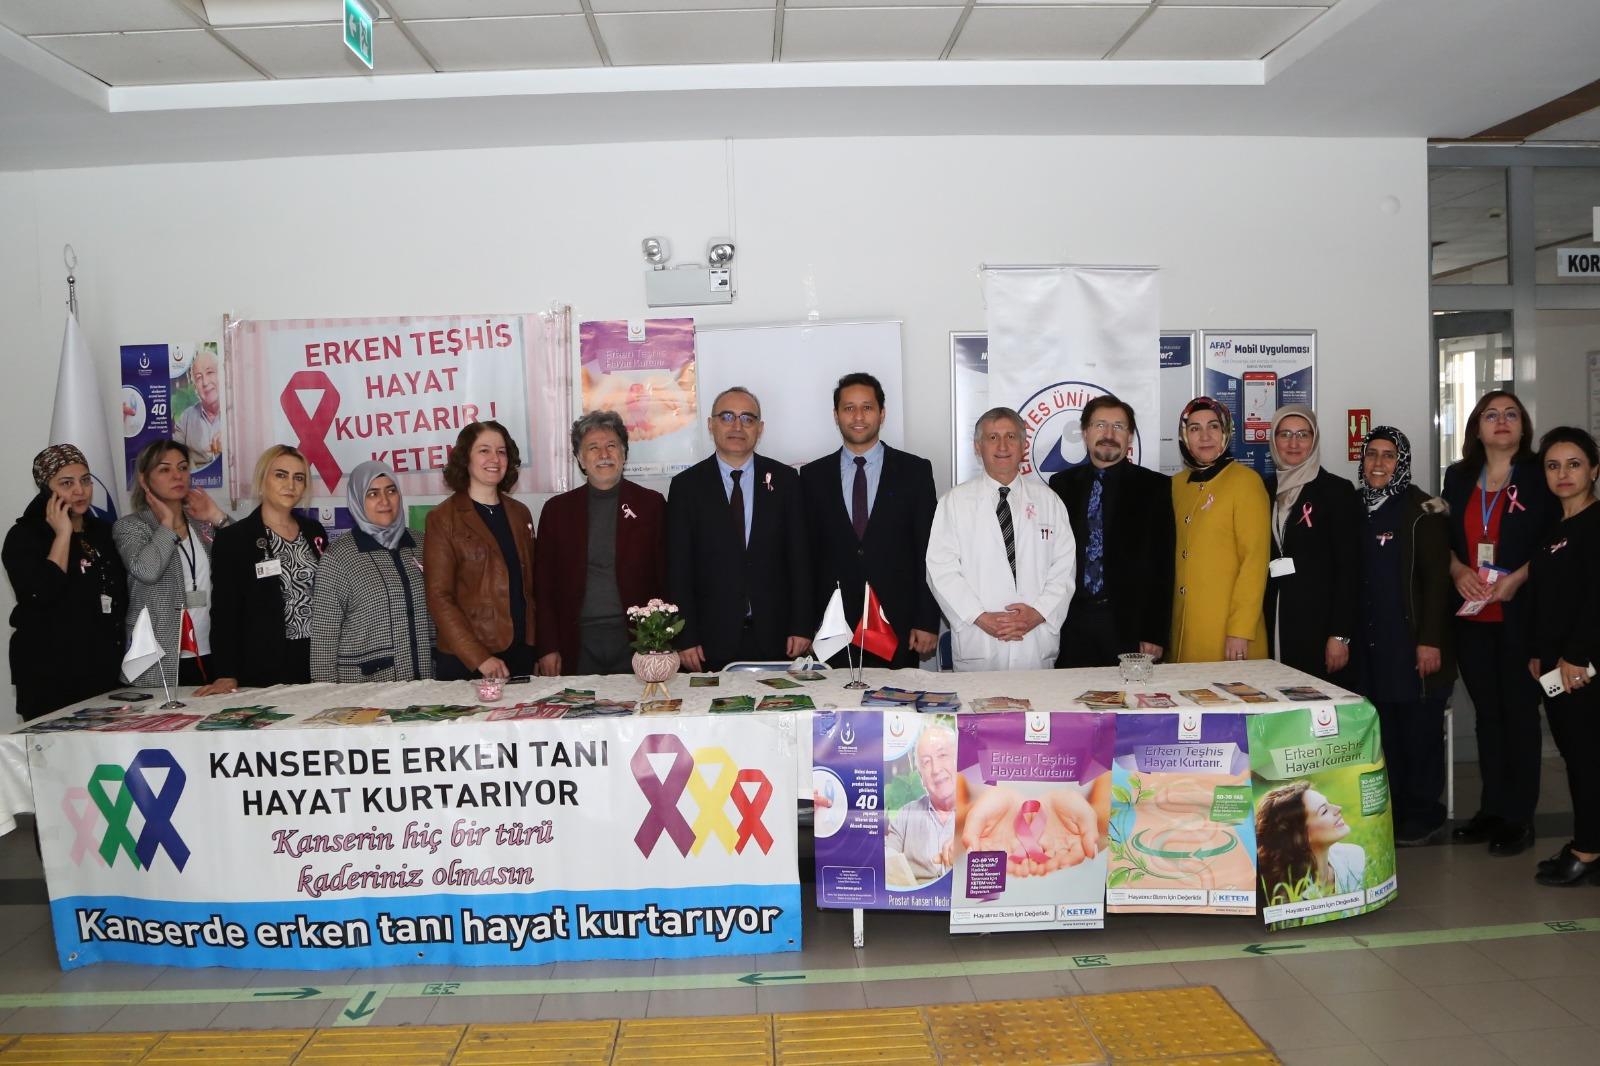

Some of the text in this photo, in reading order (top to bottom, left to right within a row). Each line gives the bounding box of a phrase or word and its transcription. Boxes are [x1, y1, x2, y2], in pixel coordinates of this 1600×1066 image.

[305, 319, 513, 367] ERKEN TEŞHİS
[1210, 341, 1231, 349] AFAD
[1235, 344, 1309, 356] Mobil Uygulaması
[365, 367, 458, 399] HAYAT
[151, 404, 167, 416] 40
[334, 403, 480, 441] KURTARIR
[1145, 746, 1224, 758] Erken Teşhis
[1284, 739, 1365, 761] Erken Teşhis
[209, 740, 609, 778] KANSERDE ERKEN TANI
[992, 752, 1077, 768] Erken Teşhis
[1144, 758, 1178, 769] Hayat
[1286, 759, 1320, 773] Hayat
[991, 767, 1026, 779] Hayat
[242, 780, 580, 816] HAYAT KURTARIYOR
[856, 794, 878, 810] 40
[271, 818, 554, 858] Kanserin hiç bir türü
[297, 859, 535, 898] kaderiniz olmasın
[888, 895, 951, 907] Prostat Kanseri Nedir
[1067, 908, 1096, 916] KETEM
[75, 902, 784, 951] Kanserde erken tanı hayat kurtarıyor
